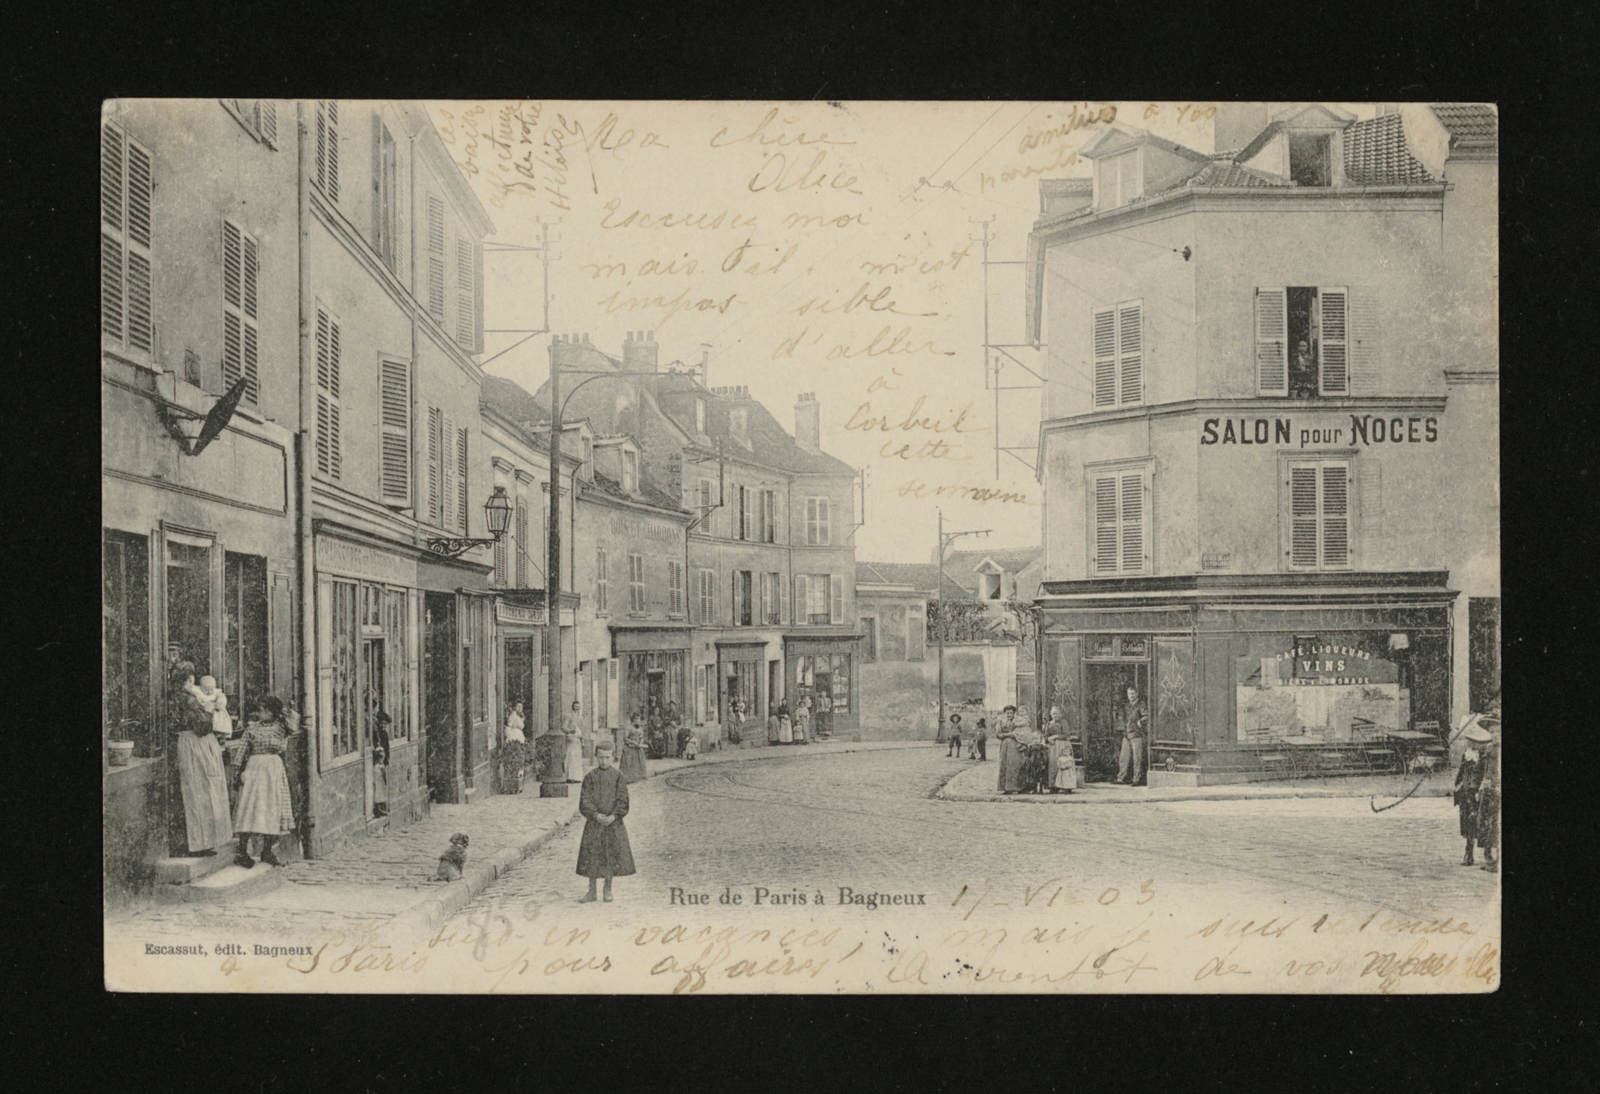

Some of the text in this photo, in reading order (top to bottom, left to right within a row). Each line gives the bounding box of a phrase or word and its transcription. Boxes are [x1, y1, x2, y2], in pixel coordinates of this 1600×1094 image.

[1200, 414, 1438, 449] SALON pour NOCES
[1302, 660, 1346, 673] VINS
